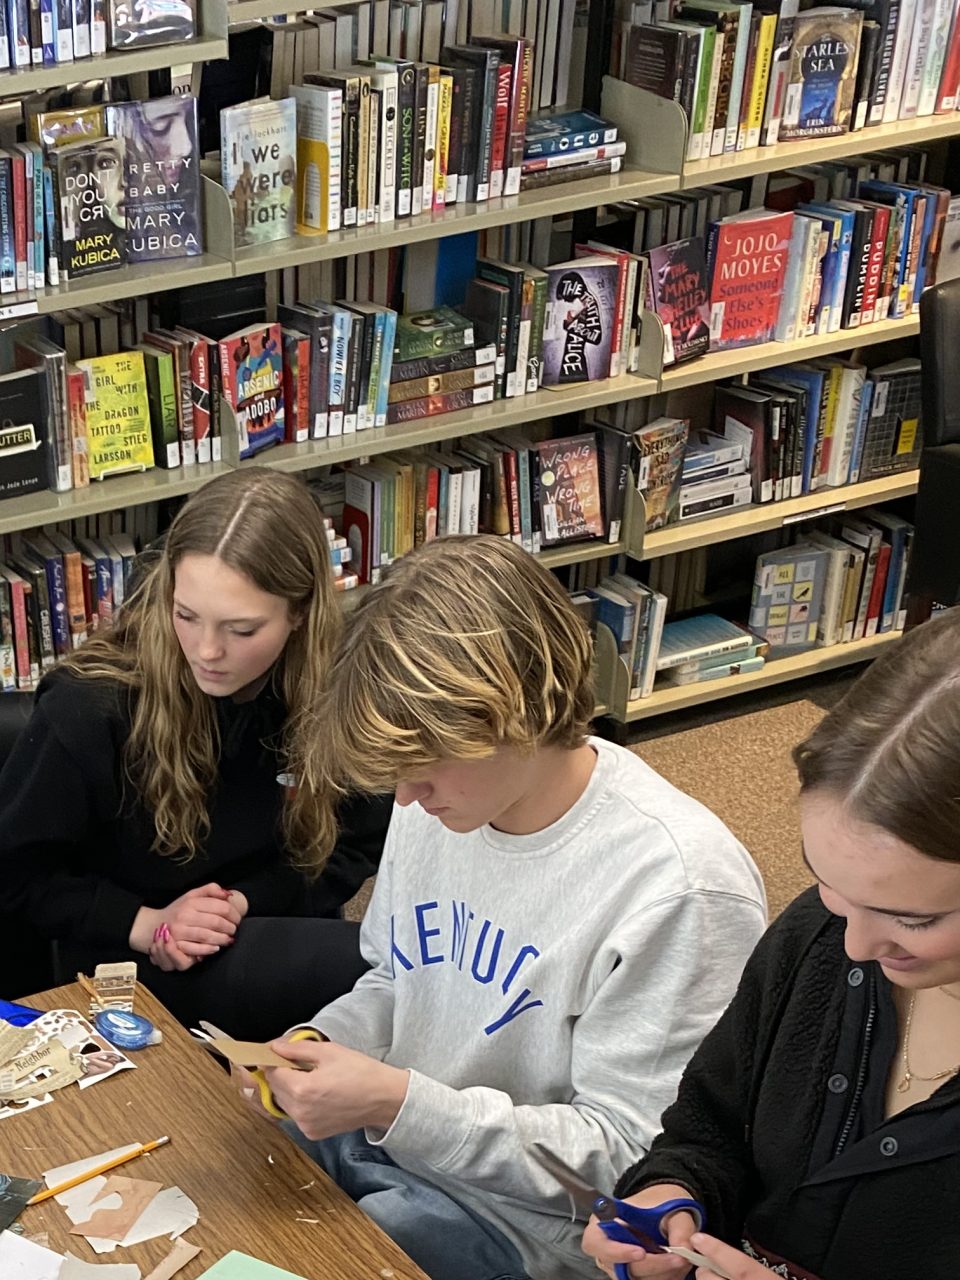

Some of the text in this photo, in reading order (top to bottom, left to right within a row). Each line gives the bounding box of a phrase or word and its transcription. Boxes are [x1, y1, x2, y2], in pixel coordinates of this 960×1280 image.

[794, 39, 855, 59] STARLESS
[810, 60, 835, 72] SEA
[496, 70, 511, 106] Wolf
[785, 125, 844, 138] MORGENSTERN
[806, 118, 825, 127] ERIN
[251, 143, 280, 163] we
[386, 126, 394, 170] WICKED
[401, 107, 413, 189] SON WITC
[129, 158, 191, 175] RETTY
[130, 183, 180, 198] BABY
[243, 169, 295, 194] were
[72, 189, 109, 206] YOU
[144, 204, 165, 212] GOOD
[250, 201, 289, 226] iars
[126, 211, 186, 232] MARY
[75, 233, 114, 251] MARY
[125, 233, 199, 253] UBICA
[730, 233, 778, 258] JOJO
[71, 248, 121, 269] KUBICA
[720, 253, 783, 281] MOYES
[855, 242, 872, 312] DUMPLIN'
[864, 241, 883, 311] PUDDIN'
[562, 280, 583, 296] THE
[719, 277, 779, 299] Someone
[581, 291, 601, 332] TRUTH
[728, 296, 765, 313] Else's
[568, 320, 601, 341] ABOUT
[726, 315, 763, 332] Shoes
[220, 344, 229, 375] ARSENIC
[563, 332, 583, 376] ALICE
[115, 361, 132, 372] THE
[197, 357, 205, 384] EXTRA
[334, 335, 345, 397] NOWHERE BOY
[96, 375, 116, 387] GIRL
[115, 383, 138, 396] WITH
[239, 372, 279, 398] ARSENIC
[85, 401, 101, 412] THE
[254, 392, 265, 401] and
[105, 406, 139, 420] DRAGON
[163, 394, 175, 429] LIAR
[245, 396, 277, 420] ADOBO
[91, 423, 121, 437] TATTOO
[123, 434, 148, 447] STIEG
[93, 449, 132, 464] LARSSON
[542, 446, 590, 469] WRONG
[555, 461, 593, 481] PLACE
[545, 483, 591, 504] WRONG
[778, 569, 790, 579] ALL
[392, 900, 543, 1035] KENUCY
[14, 1046, 52, 1072] Neighbor
